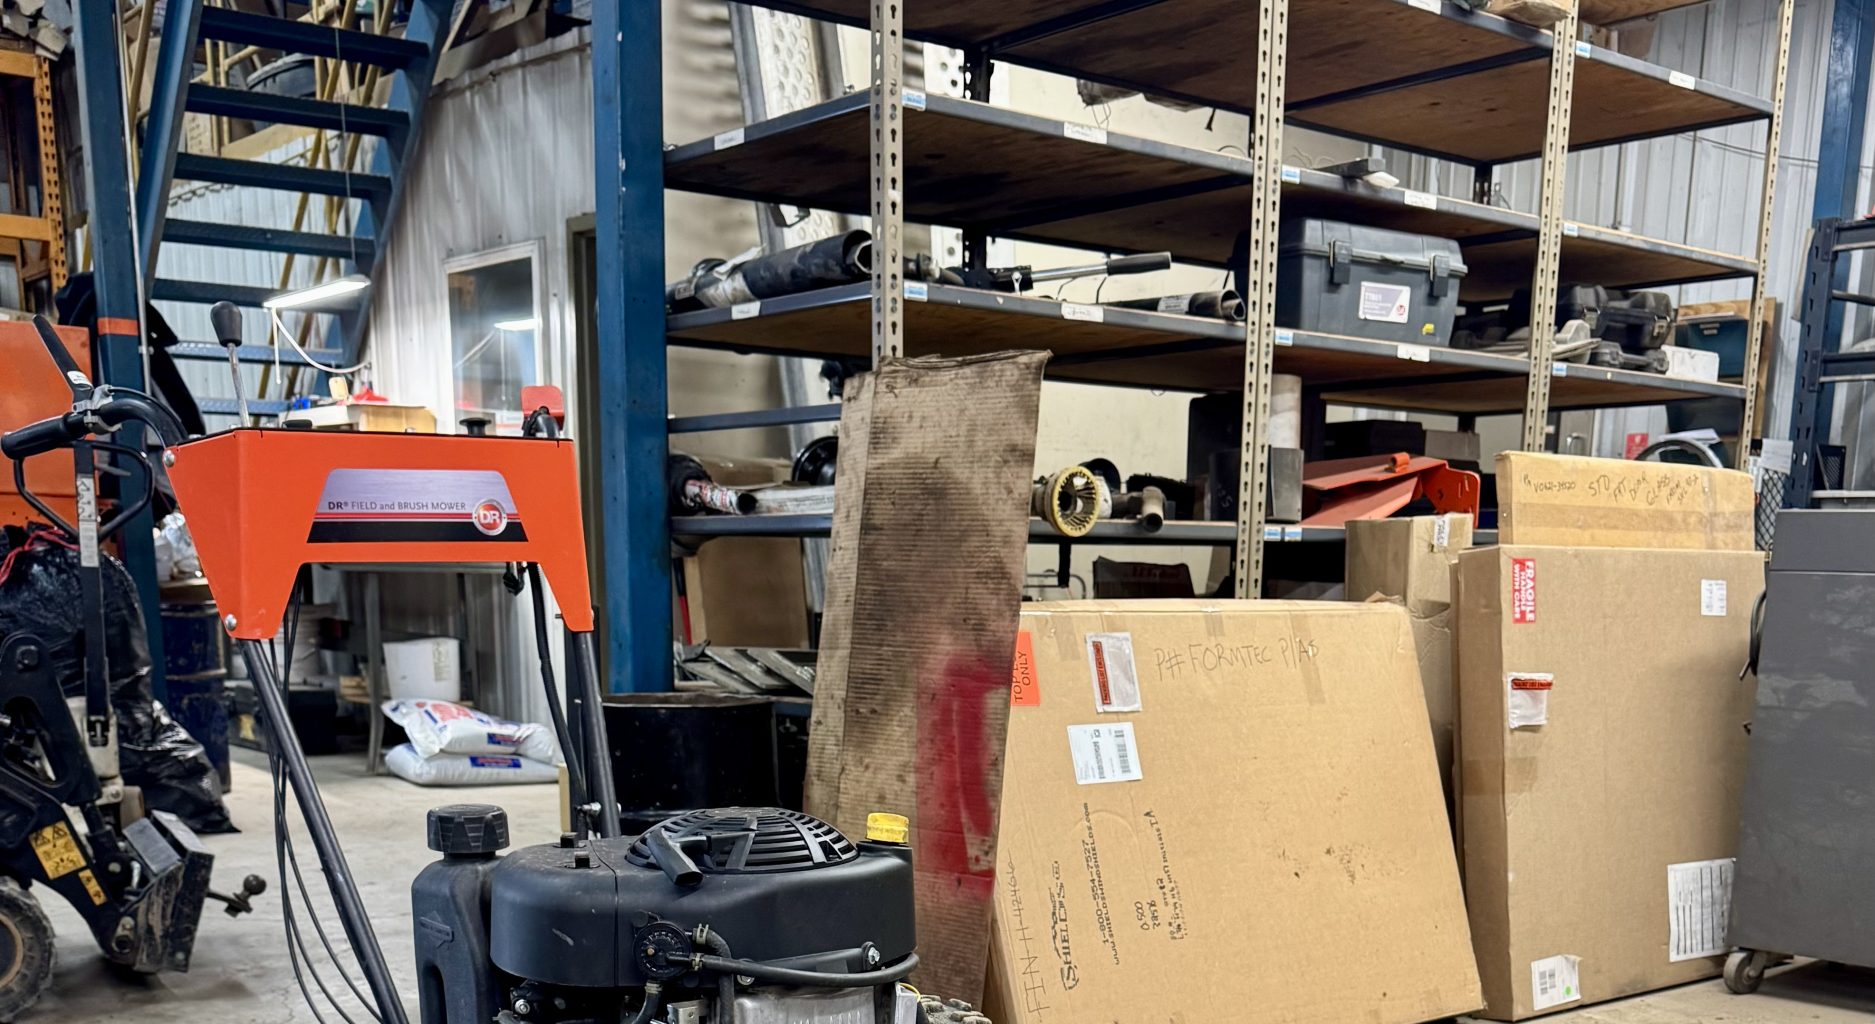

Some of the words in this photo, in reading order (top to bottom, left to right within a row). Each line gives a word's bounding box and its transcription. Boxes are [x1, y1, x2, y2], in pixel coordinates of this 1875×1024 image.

[351, 501, 378, 511] FIELD
[380, 501, 395, 511] and
[397, 501, 429, 511] BRUSH
[431, 501, 467, 511] MOWER
[479, 509, 502, 525] DR
[1525, 560, 1535, 621] FRAGILE
[1017, 650, 1031, 686] ONLY
[1189, 643, 1272, 673] FORMTEC
